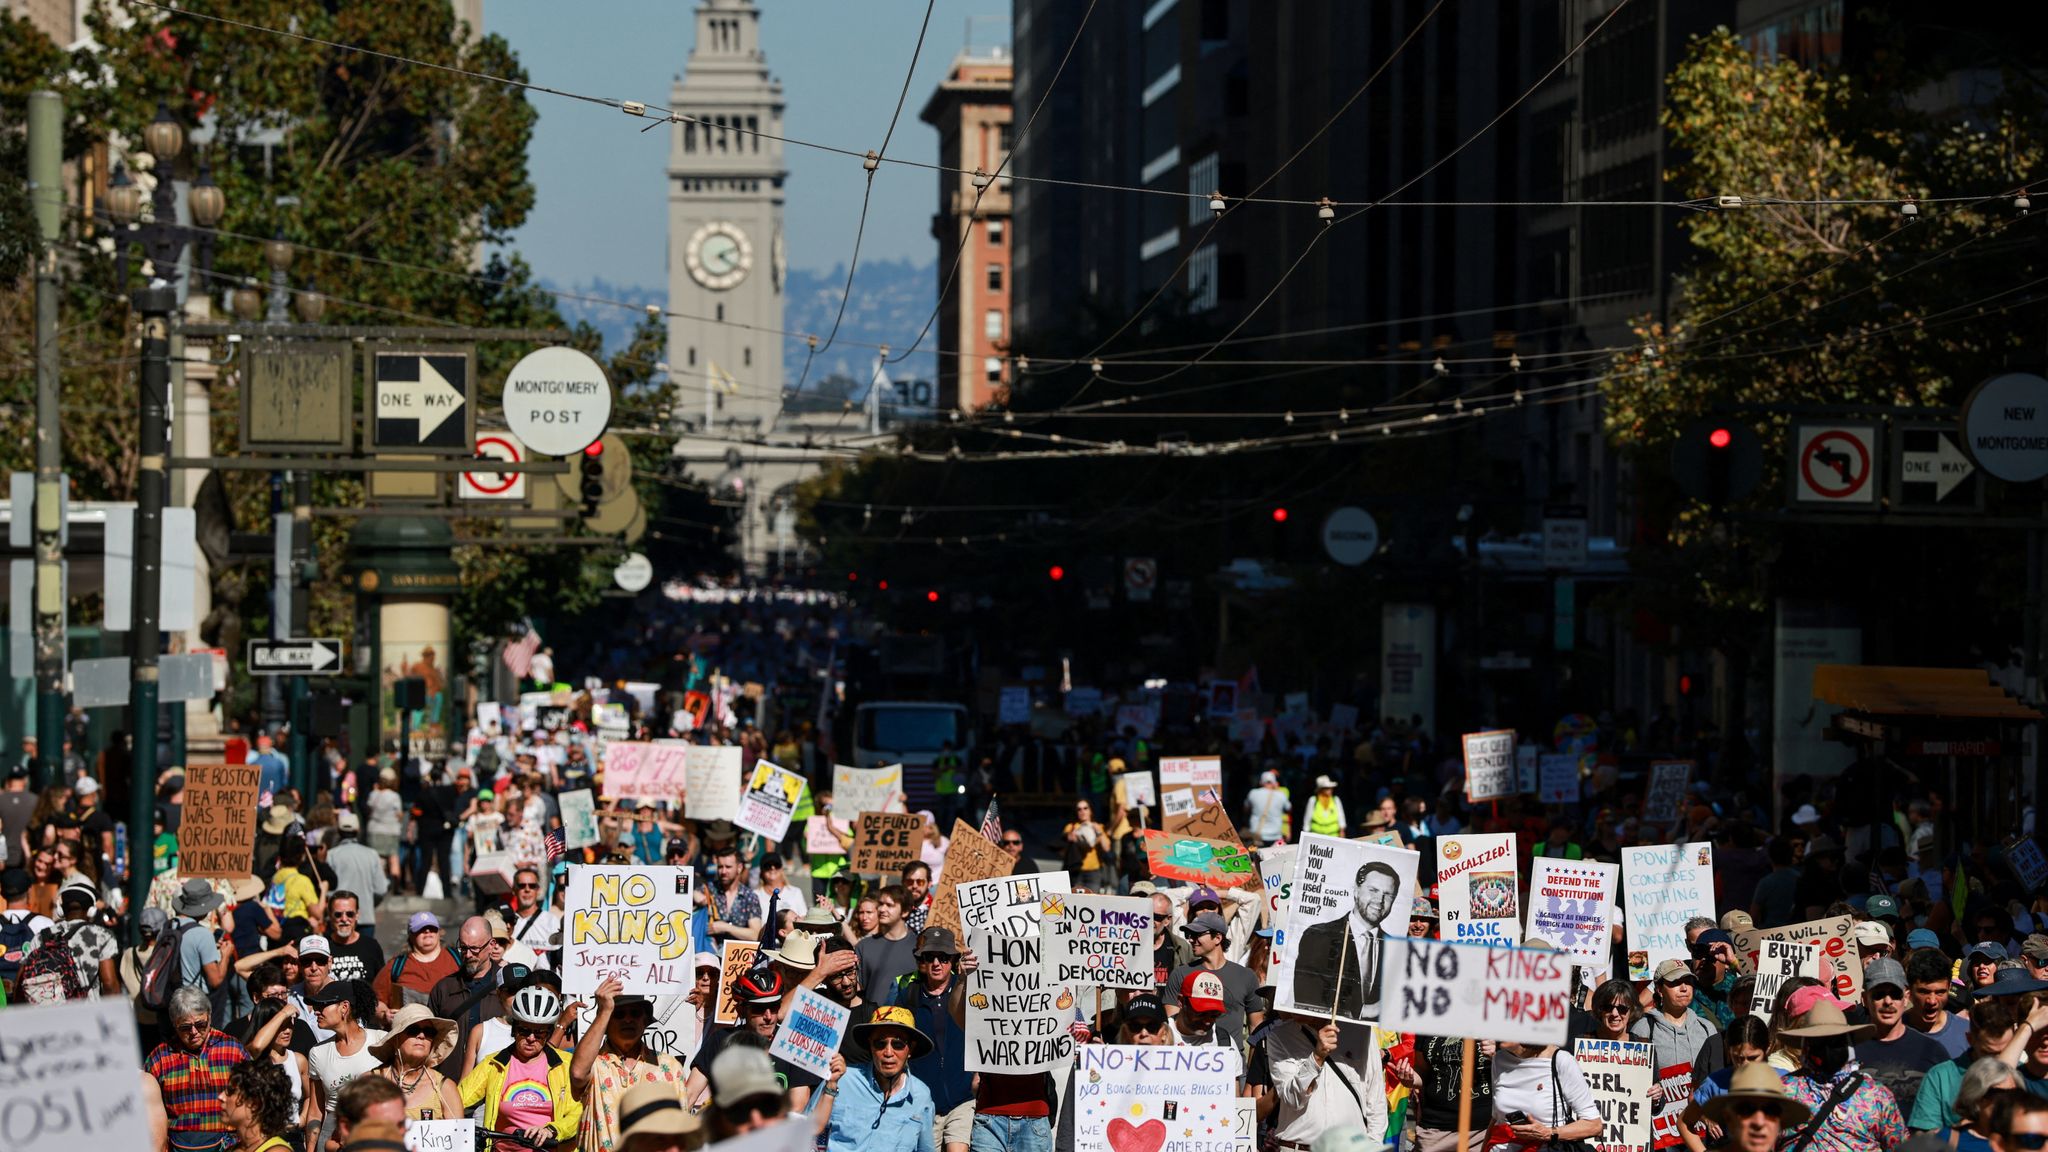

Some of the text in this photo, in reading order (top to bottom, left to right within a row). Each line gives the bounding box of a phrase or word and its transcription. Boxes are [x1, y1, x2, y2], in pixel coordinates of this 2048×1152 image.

[514, 380, 599, 395] MONTGOMERY
[381, 393, 455, 407] ONE WAY
[530, 410, 583, 424] POST
[2003, 407, 2036, 421] NEW
[1905, 460, 1968, 474] ONE WAY
[1163, 760, 1176, 773] ARE
[1179, 761, 1190, 772] WE
[188, 767, 260, 786] THE BOSTON
[187, 789, 254, 806] TEA PARTY
[185, 807, 247, 824] WAS THE
[864, 815, 920, 830] DEFUND
[183, 827, 249, 848] ORIGINAL
[864, 829, 910, 847] ICE
[858, 849, 913, 860] NO HUMAN
[1309, 844, 1334, 858] Would
[1632, 849, 1690, 867] POWER
[180, 850, 198, 872] NO
[200, 849, 228, 872] KINGS
[857, 859, 905, 872] IS ILLEG
[1307, 857, 1323, 870] YOU
[1438, 838, 1510, 884] RADICALIZED!
[1304, 869, 1326, 883] buy a
[1547, 875, 1600, 888] DEFEND THE
[1629, 869, 1696, 887] CONCEDES
[590, 873, 656, 909] NO
[957, 883, 1000, 909] LETS
[1302, 882, 1322, 894] used
[1324, 888, 1349, 897] couch
[1541, 887, 1604, 901] CONSTITUTION
[1632, 887, 1699, 907] NOTHING
[1301, 891, 1321, 905] from
[1322, 896, 1338, 908] this
[965, 902, 997, 927] GET
[1064, 905, 1150, 929] NO KINGS
[1298, 904, 1322, 916] man?
[1447, 910, 1460, 921] BY
[1539, 911, 1564, 920] AGAINST
[1575, 915, 1601, 923] ENEMIES
[1634, 908, 1698, 928] WITHOUT
[572, 908, 691, 961] KINGS
[1055, 921, 1141, 941] IN AMERICA
[1457, 922, 1501, 937] BASIC
[1535, 919, 1605, 932] FOREIGN AND DOMESTIC
[1068, 939, 1141, 956] PROTECT
[1638, 933, 1686, 950] DEMA
[575, 948, 643, 968] JUSTICE
[987, 935, 1041, 968] HON
[1768, 942, 1813, 961] BUILT
[1087, 954, 1127, 970] OUR
[1405, 943, 1563, 981] NO KINGS
[1781, 958, 1803, 977] BY
[595, 962, 682, 984] FOR ALL
[976, 969, 1040, 992] IF YOU
[1059, 963, 1153, 987] DEMOCRACY
[992, 992, 1051, 1014] NEVER
[1402, 986, 1451, 1021] NO
[802, 1003, 837, 1029] THIS IS WHAT
[794, 1015, 833, 1044] DEMOCRACY
[984, 1017, 1058, 1037] TEXTED
[788, 1030, 828, 1058] LOOKS LIKE
[976, 1034, 1072, 1066] WAR PLANS
[1085, 1047, 1225, 1073] NO KINGS
[1079, 1083, 1100, 1101] NO
[420, 1124, 453, 1150] King
[1080, 1124, 1100, 1136] WE
[1080, 1140, 1233, 1152] THE AMERICA
